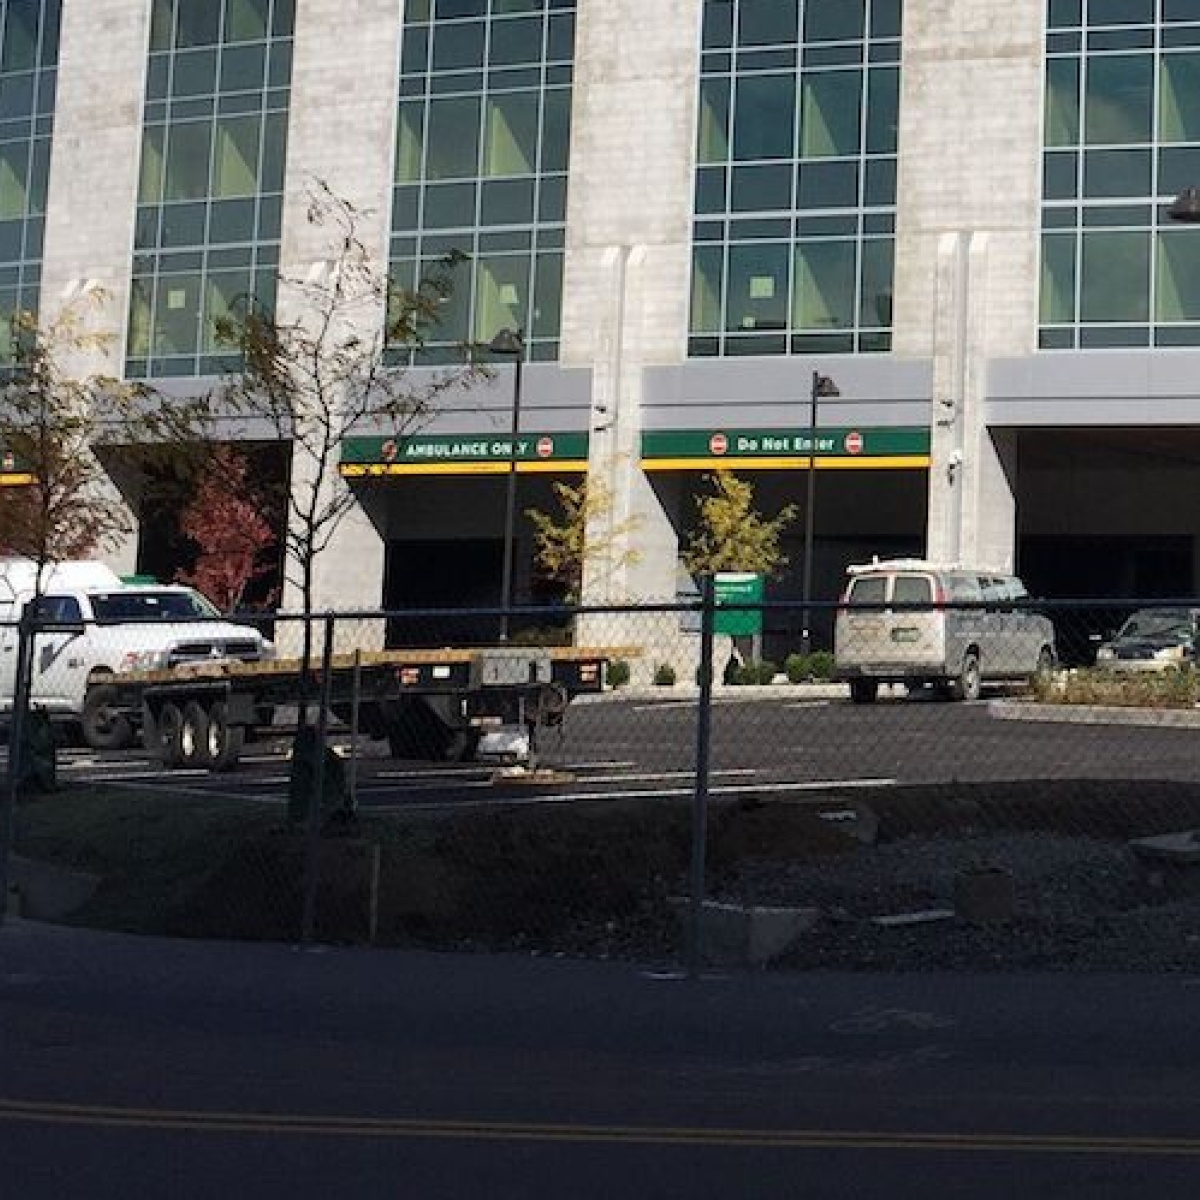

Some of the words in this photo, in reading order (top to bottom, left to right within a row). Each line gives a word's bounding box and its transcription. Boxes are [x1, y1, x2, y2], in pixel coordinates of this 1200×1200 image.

[406, 443, 489, 458] AMBULANCE
[491, 442, 528, 456] ONY
[737, 437, 758, 451] Do
[761, 437, 790, 451] Not
